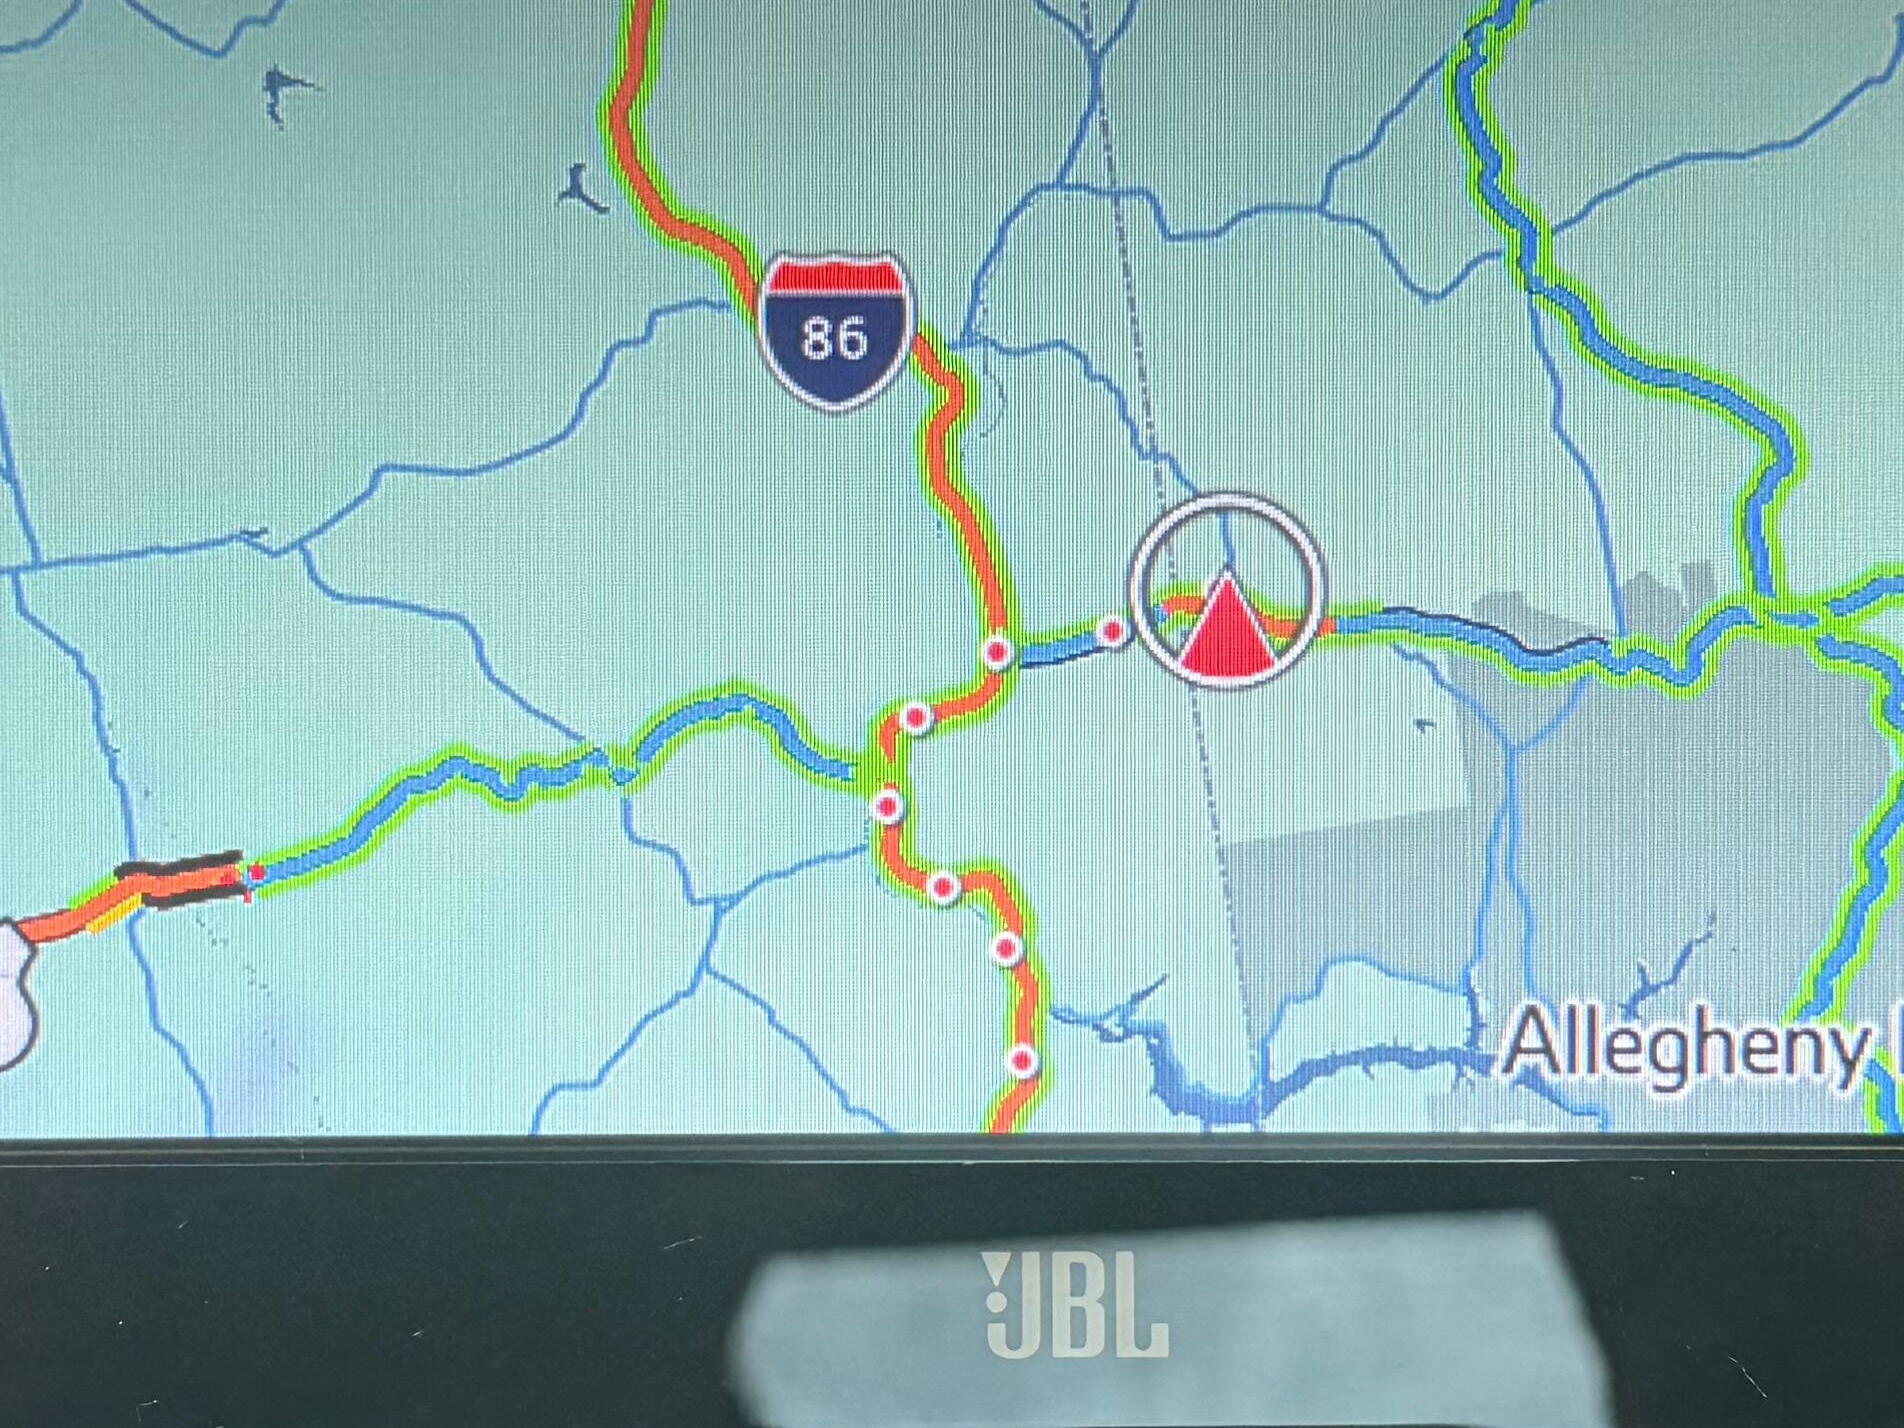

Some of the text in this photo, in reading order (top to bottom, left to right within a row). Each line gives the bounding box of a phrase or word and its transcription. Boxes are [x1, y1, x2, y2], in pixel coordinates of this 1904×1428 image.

[801, 315, 868, 360] 86
[1502, 1002, 1870, 1093] Allegheny
[981, 1250, 1170, 1360] JBL
